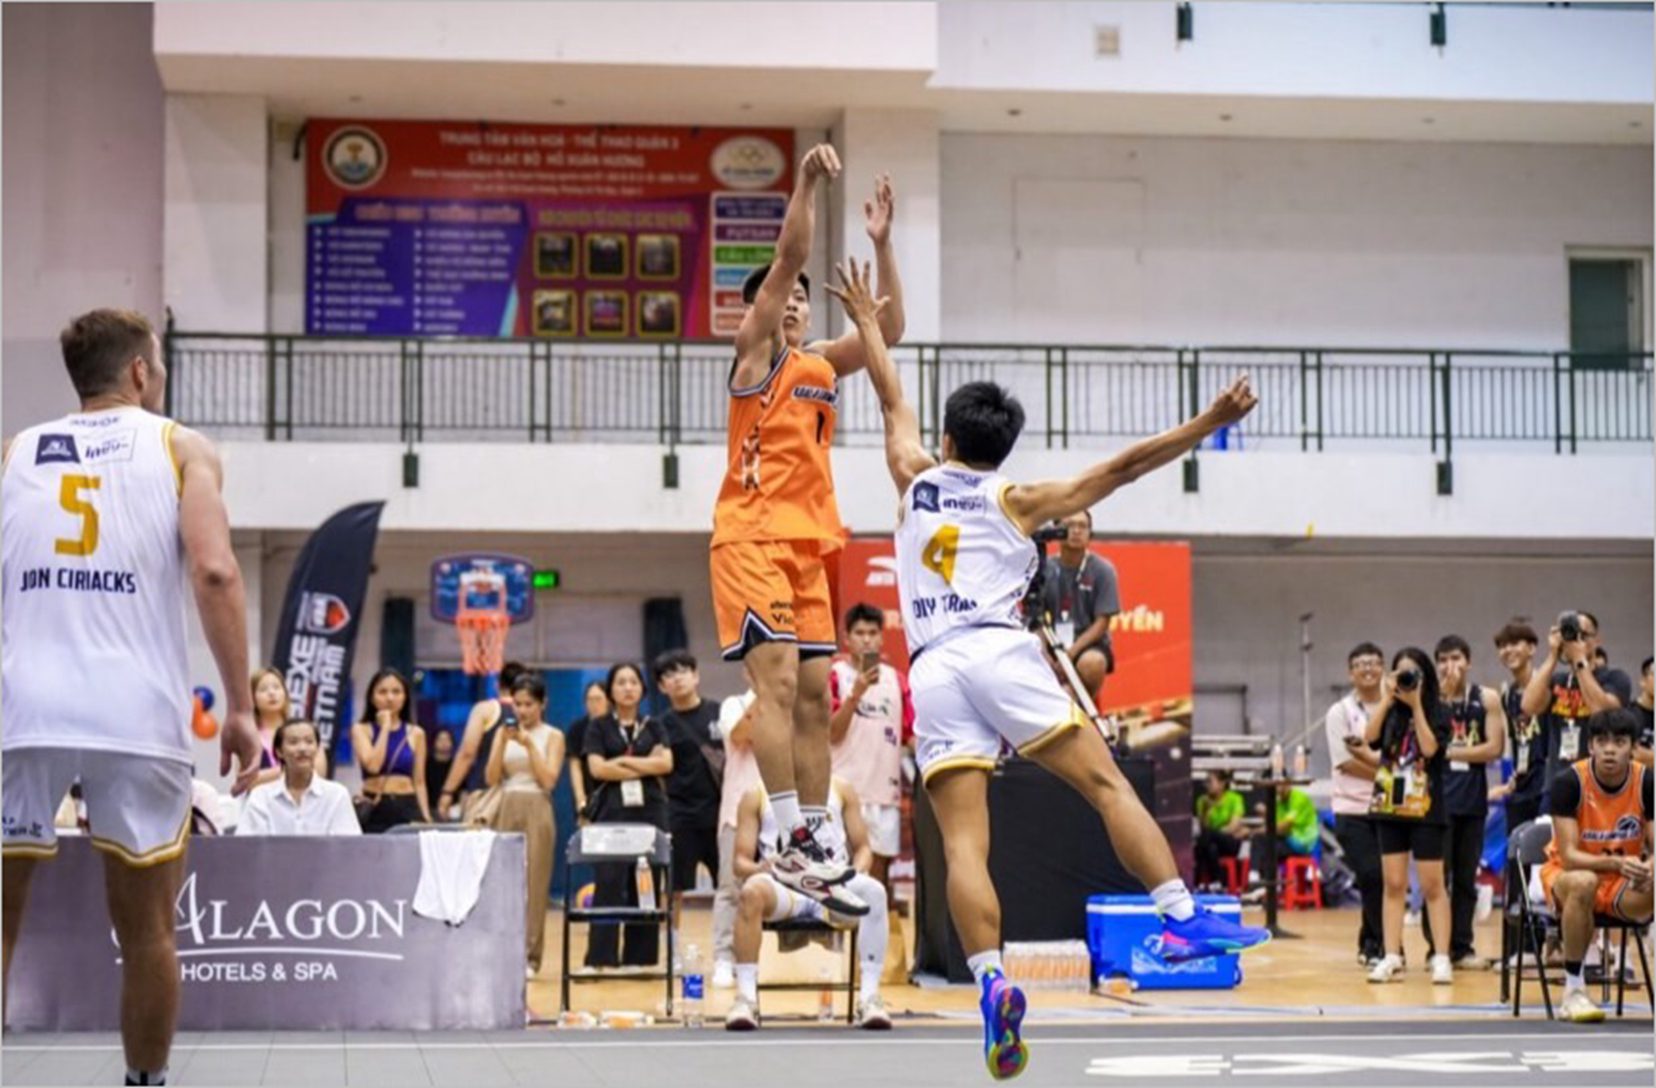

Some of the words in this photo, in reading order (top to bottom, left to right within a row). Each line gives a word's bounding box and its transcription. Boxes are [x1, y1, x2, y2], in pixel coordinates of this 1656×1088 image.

[54, 474, 101, 557] 5
[921, 524, 961, 588] 4
[20, 568, 50, 592] JON
[57, 568, 137, 594] CIRIACKS
[181, 963, 267, 982] HOTELS
[271, 962, 287, 981] &
[294, 962, 338, 981] SPA
